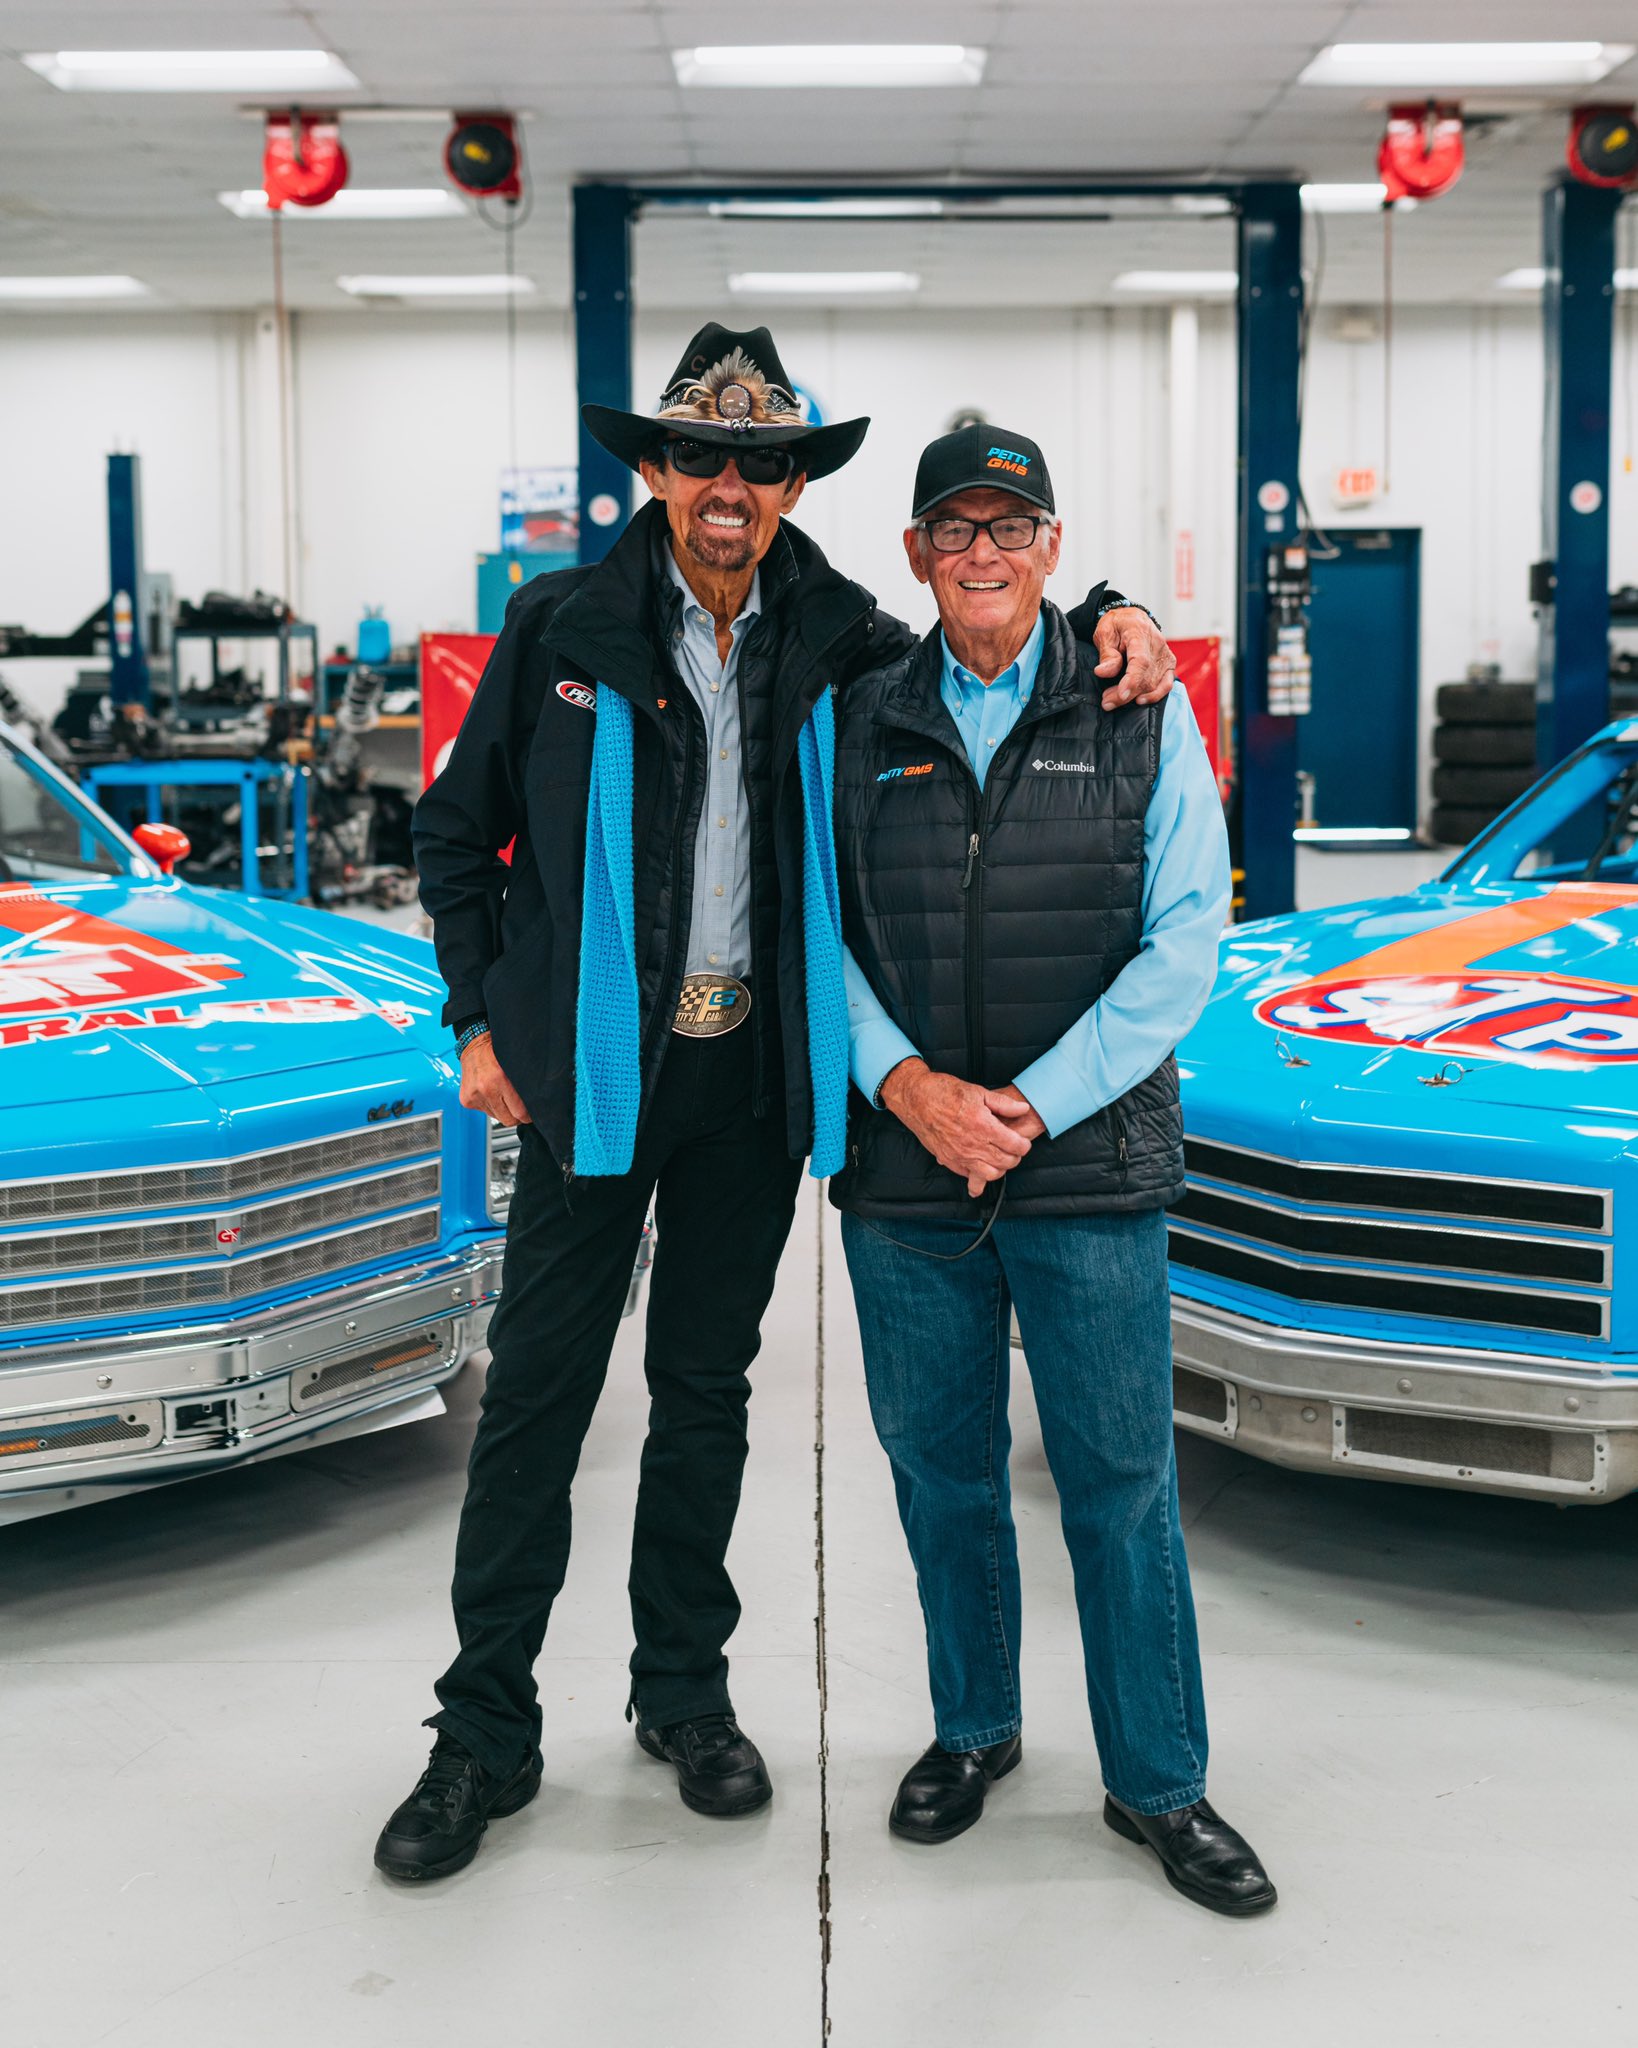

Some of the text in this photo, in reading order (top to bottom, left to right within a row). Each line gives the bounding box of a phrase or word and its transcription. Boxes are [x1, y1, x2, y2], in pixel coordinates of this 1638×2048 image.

[987, 447, 1031, 466] PETTY
[987, 458, 1028, 476] GMS
[877, 763, 934, 782] PTTY GMS
[1044, 760, 1095, 773] Columbia
[675, 1012, 696, 1023] TTY'S
[1266, 978, 1638, 1056] STP
